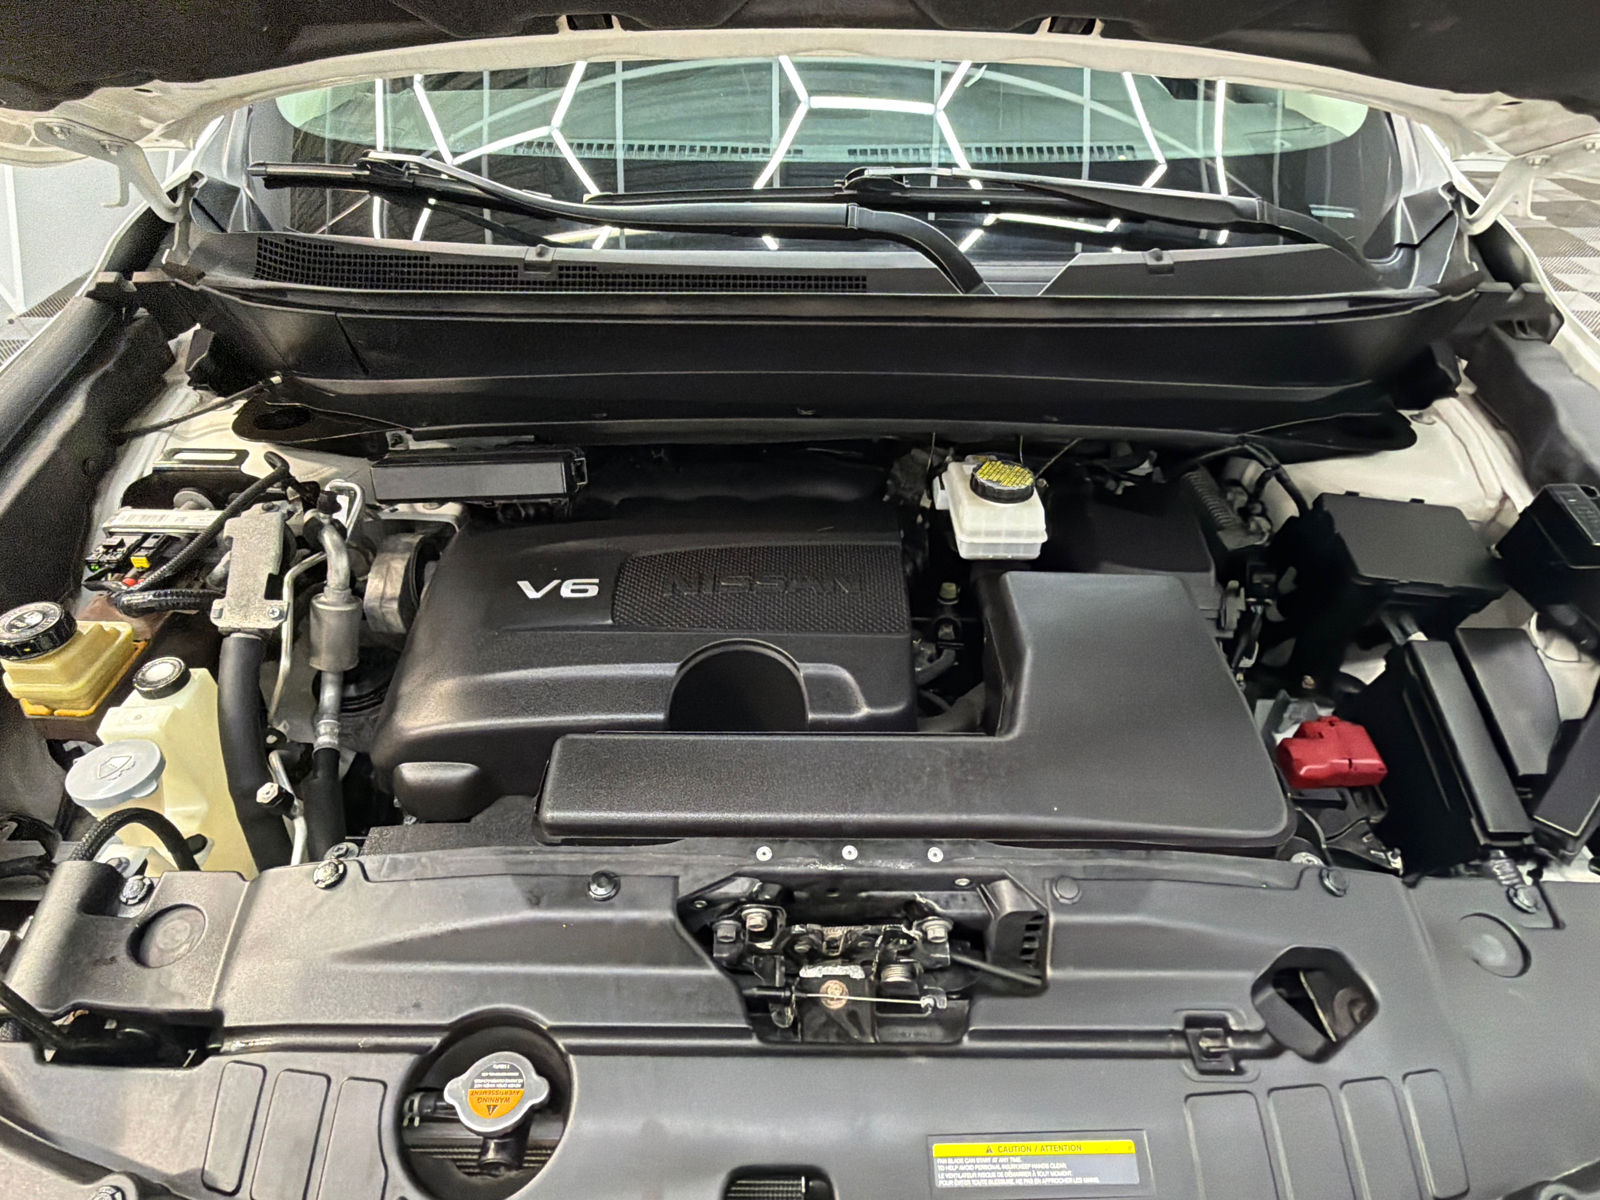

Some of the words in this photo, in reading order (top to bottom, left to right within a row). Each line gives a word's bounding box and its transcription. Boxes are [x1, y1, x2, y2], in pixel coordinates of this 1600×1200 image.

[517, 578, 600, 599] V6
[665, 574, 862, 596] NISSAN
[997, 1145, 1032, 1153] CAUTION
[1040, 1144, 1082, 1152] ATTENTION
